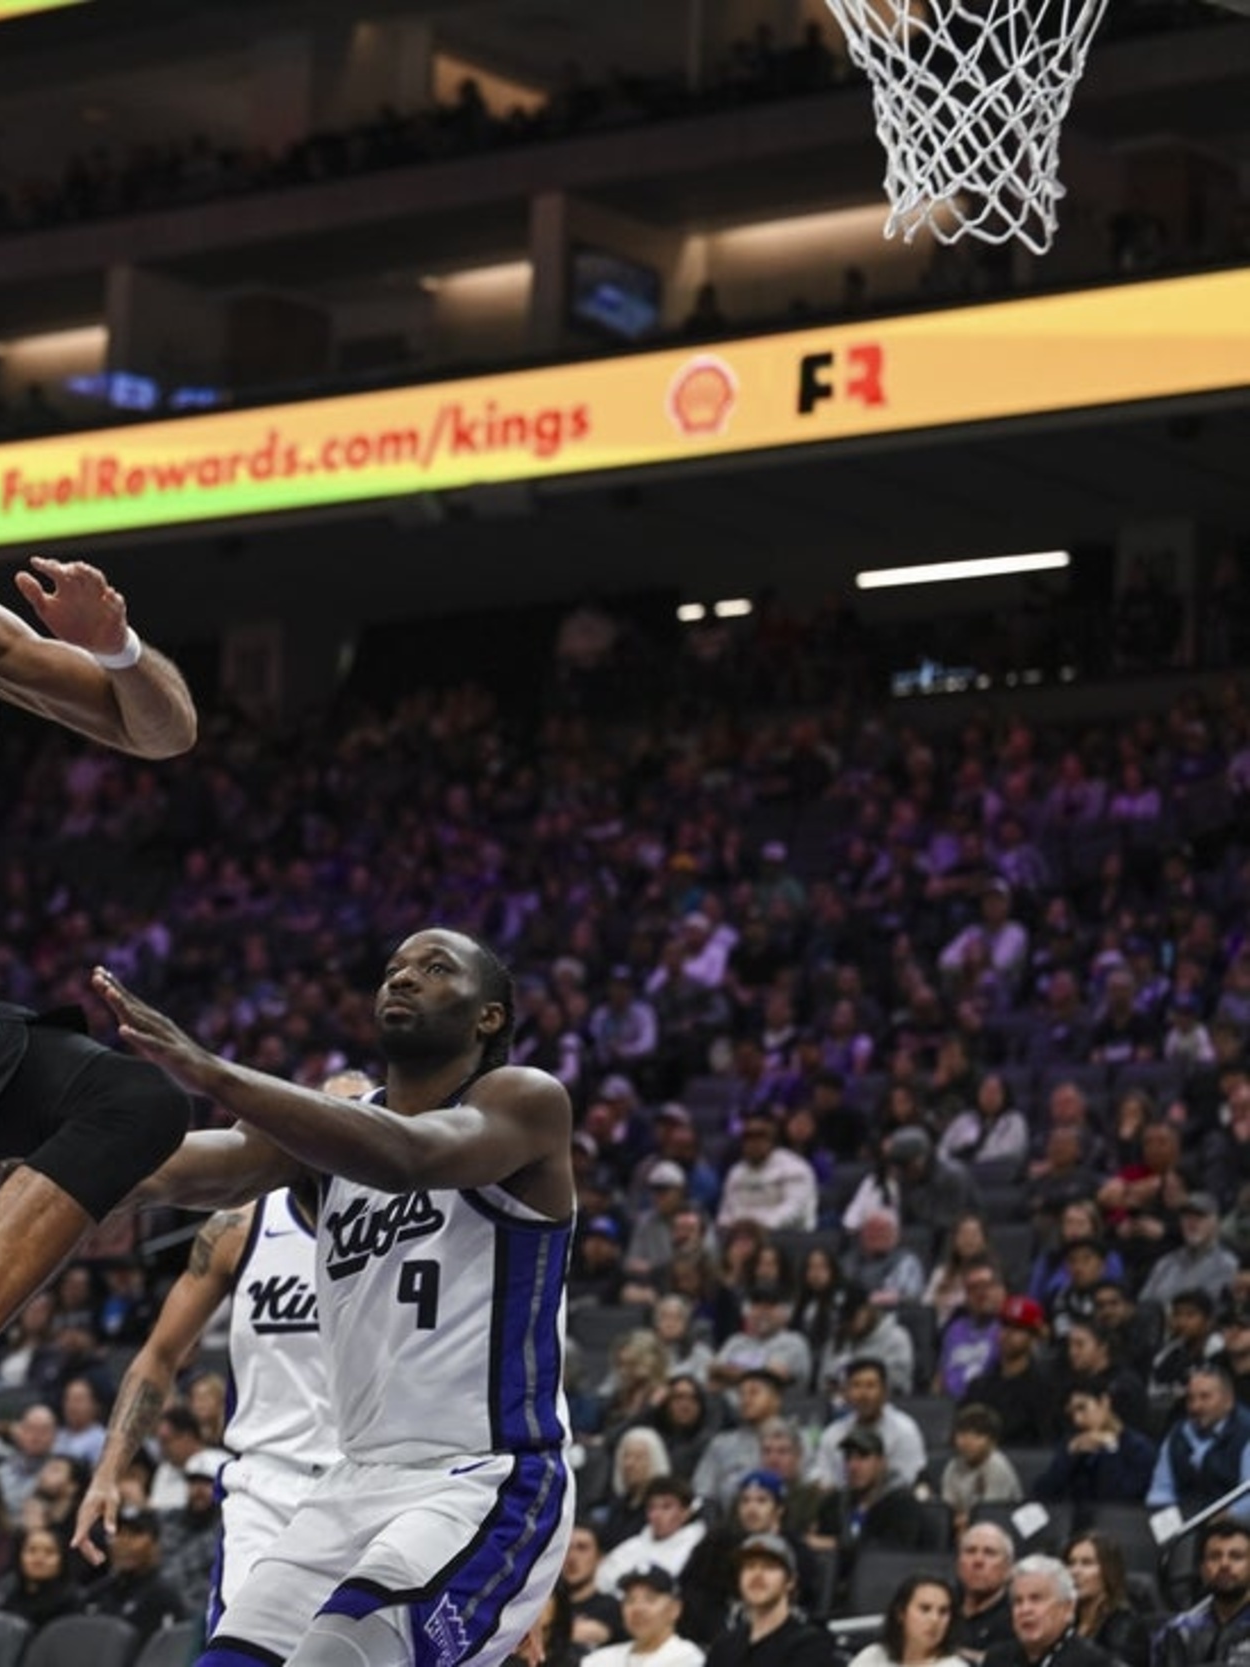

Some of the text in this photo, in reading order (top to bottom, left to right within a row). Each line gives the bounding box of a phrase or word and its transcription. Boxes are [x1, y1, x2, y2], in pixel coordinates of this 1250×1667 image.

[1, 401, 590, 512] FuelRewards.com/kings
[247, 1275, 320, 1330] Kin
[397, 1259, 440, 1330] 9
